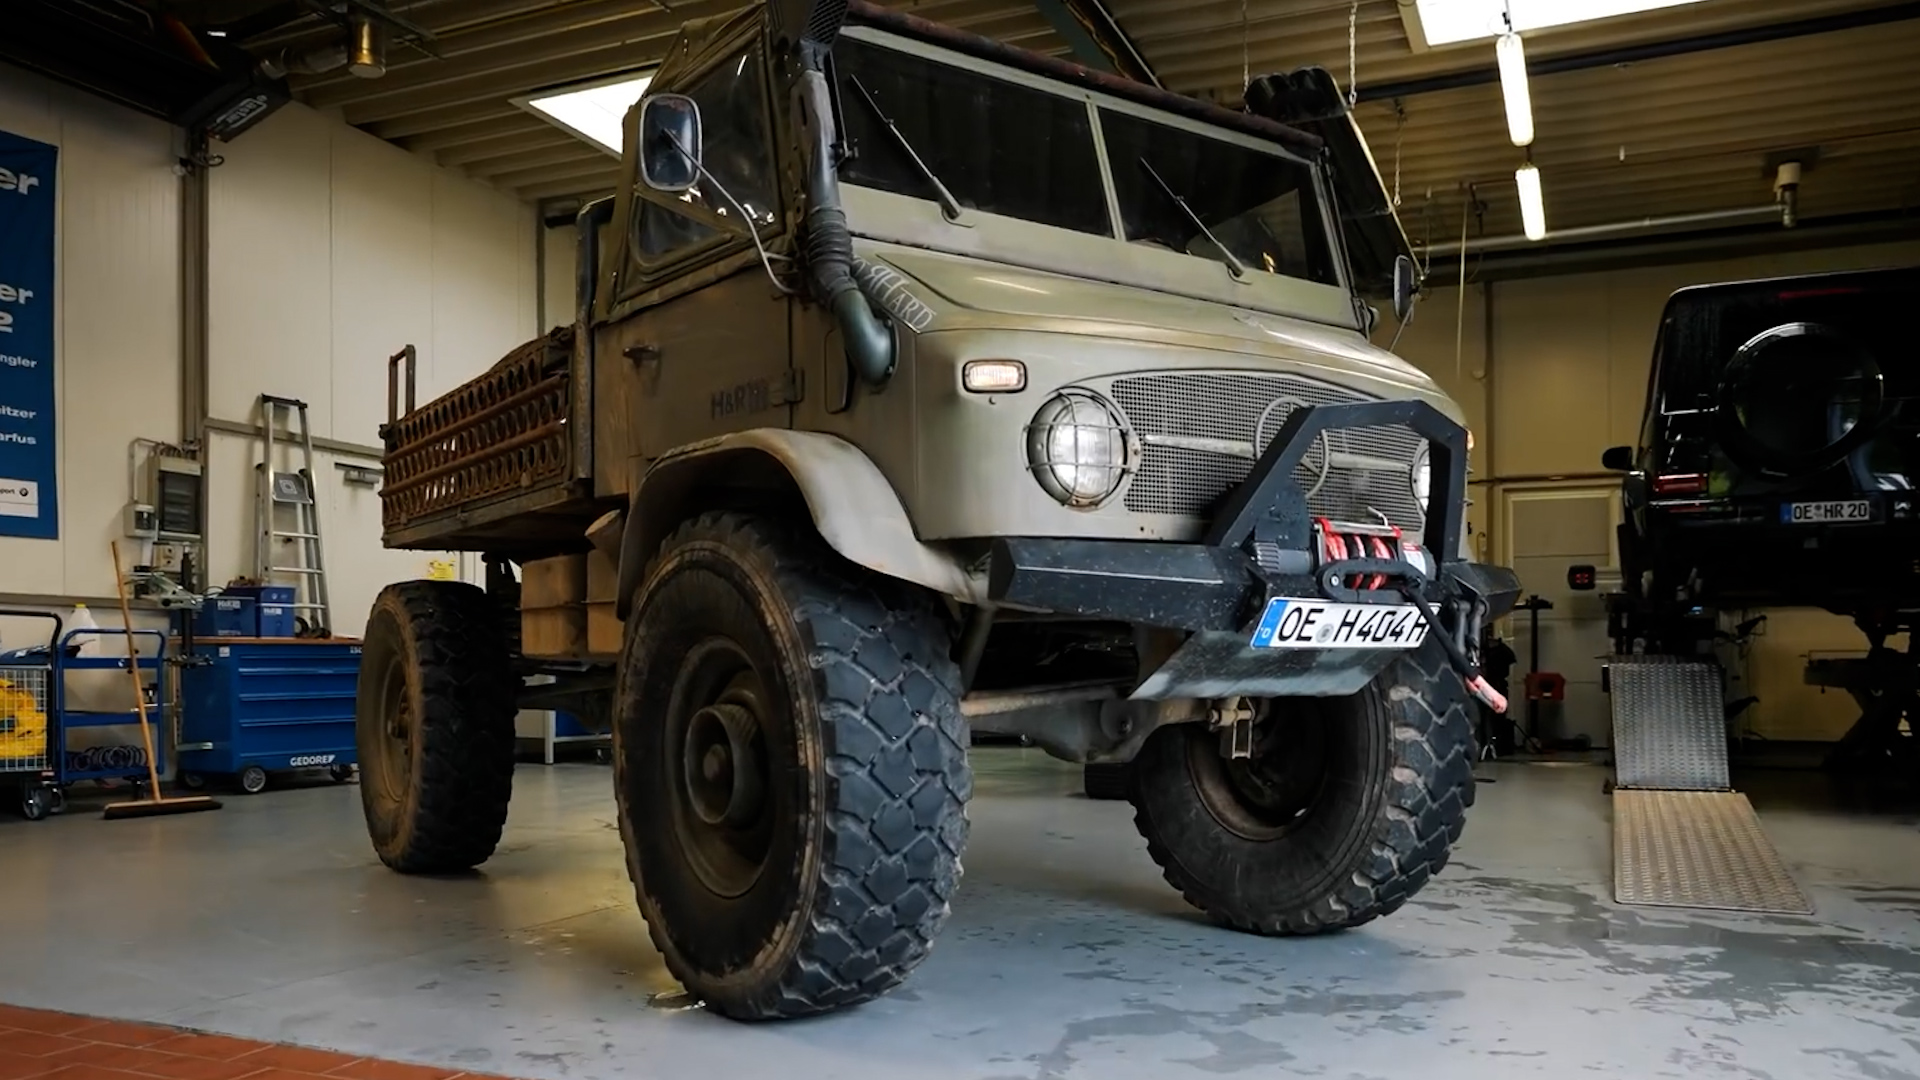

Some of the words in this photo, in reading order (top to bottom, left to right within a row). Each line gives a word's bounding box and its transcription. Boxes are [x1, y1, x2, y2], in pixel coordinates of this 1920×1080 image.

[0, 405, 36, 419] itzer
[1794, 505, 1813, 520] OE
[1824, 504, 1844, 519] HR
[1847, 503, 1867, 518] 20
[1278, 606, 1325, 642] OE
[290, 754, 329, 767] GEDORE
